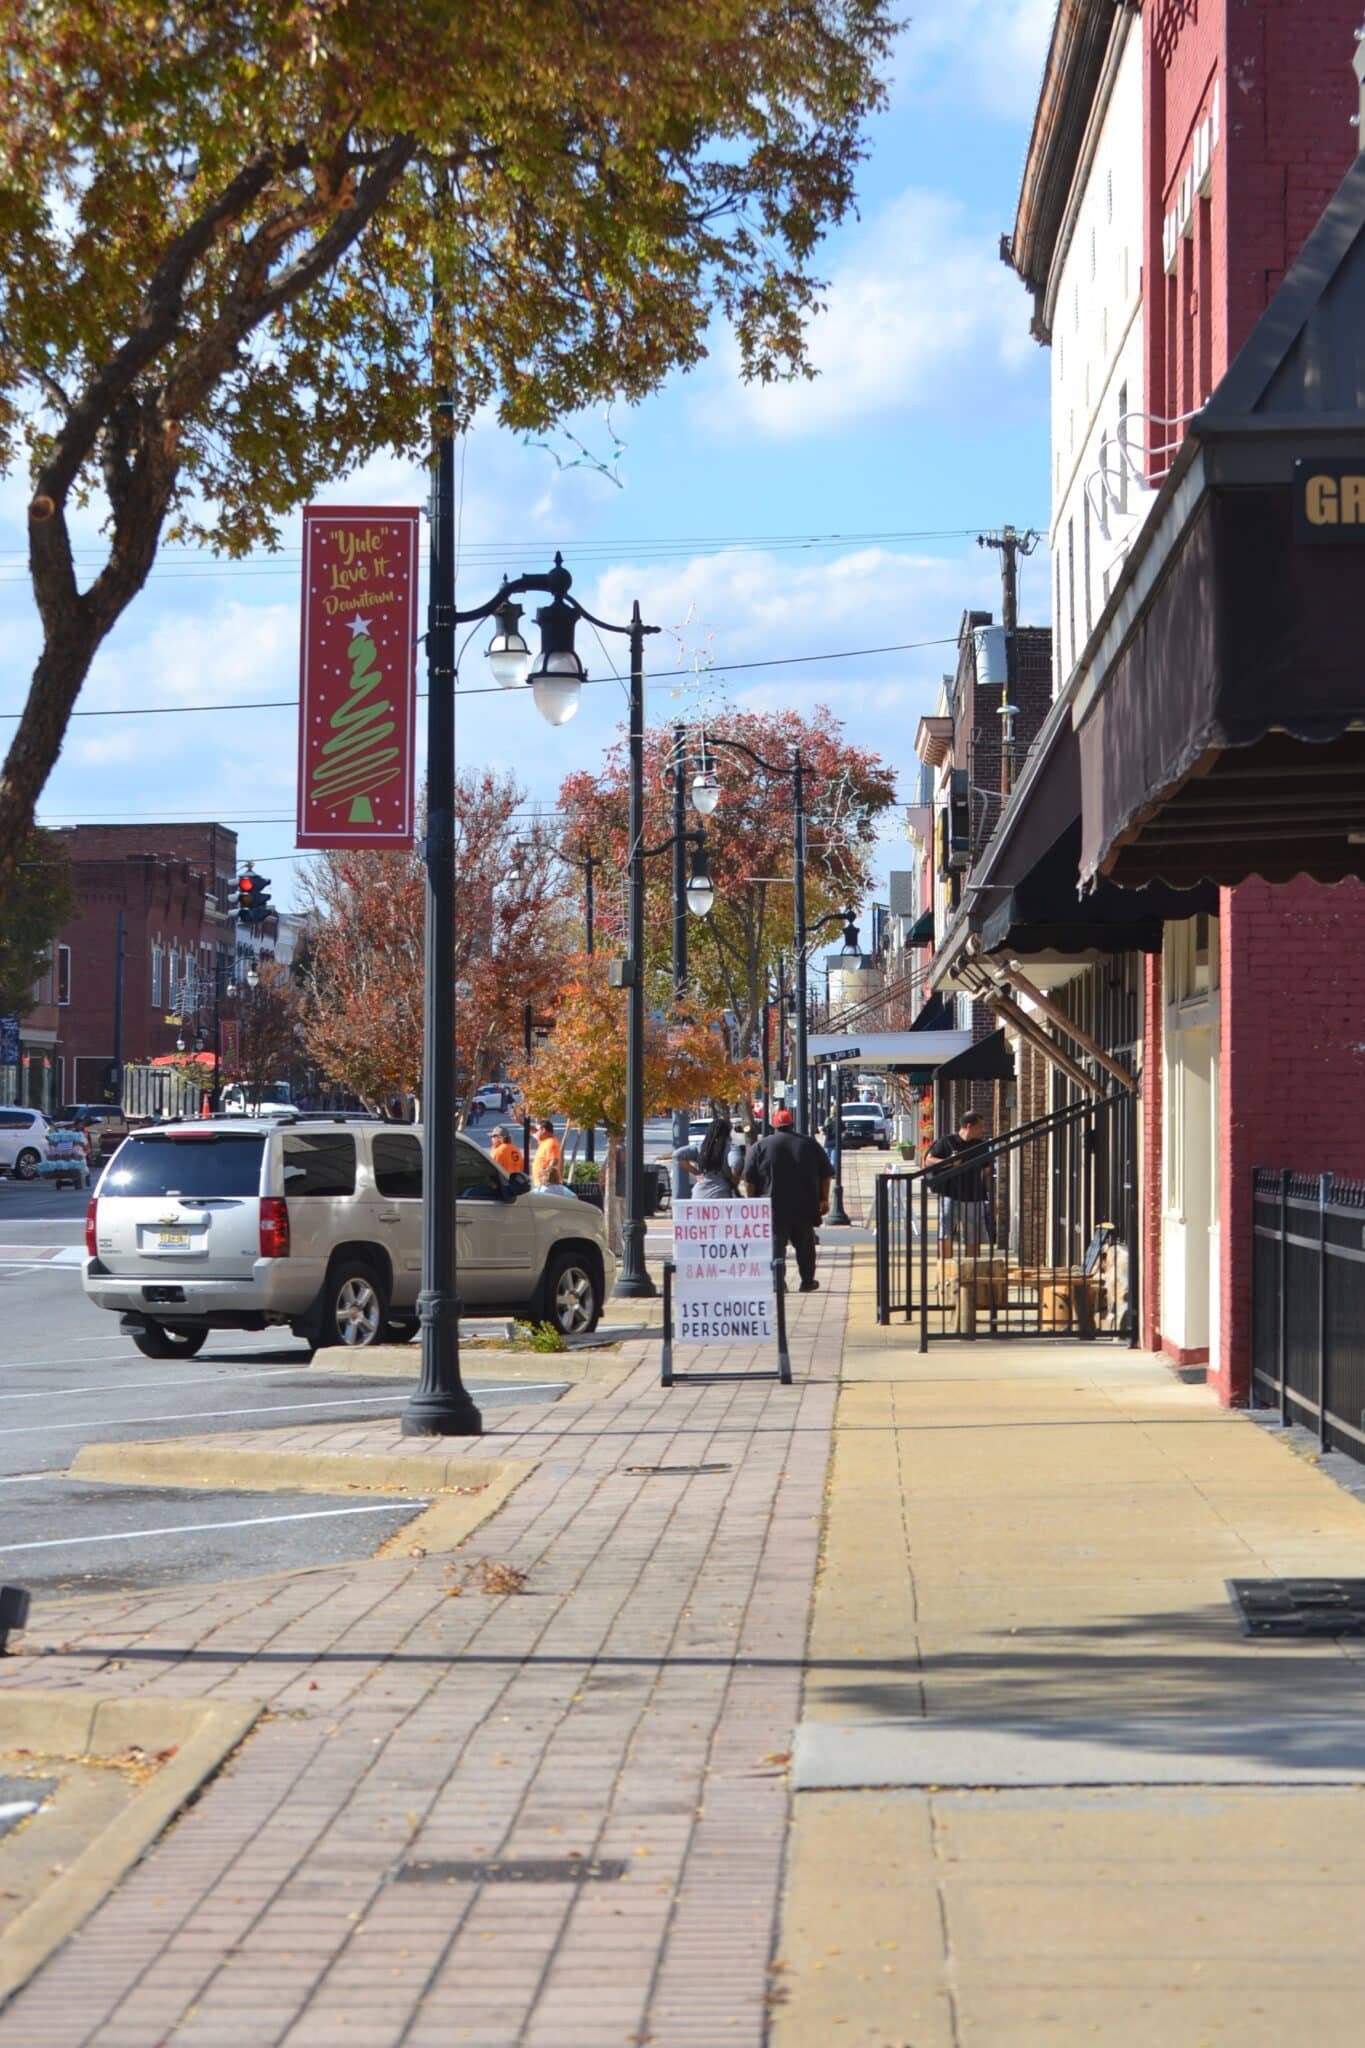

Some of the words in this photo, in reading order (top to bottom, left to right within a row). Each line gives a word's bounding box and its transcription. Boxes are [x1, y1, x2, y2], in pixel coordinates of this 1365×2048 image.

[330, 564, 370, 591] Love
[373, 556, 391, 577] It
[322, 589, 394, 615] Downtown
[686, 1206, 721, 1221] FIND
[725, 1204, 770, 1220] YOUR
[674, 1224, 718, 1241] RIGHT
[724, 1223, 770, 1240] PLACE
[700, 1243, 749, 1259] TODAY
[686, 1262, 761, 1279] 8AM-4PM
[682, 1302, 708, 1318] 1ST
[713, 1301, 766, 1318] CHOICE
[681, 1321, 771, 1338] PERSONNEL
